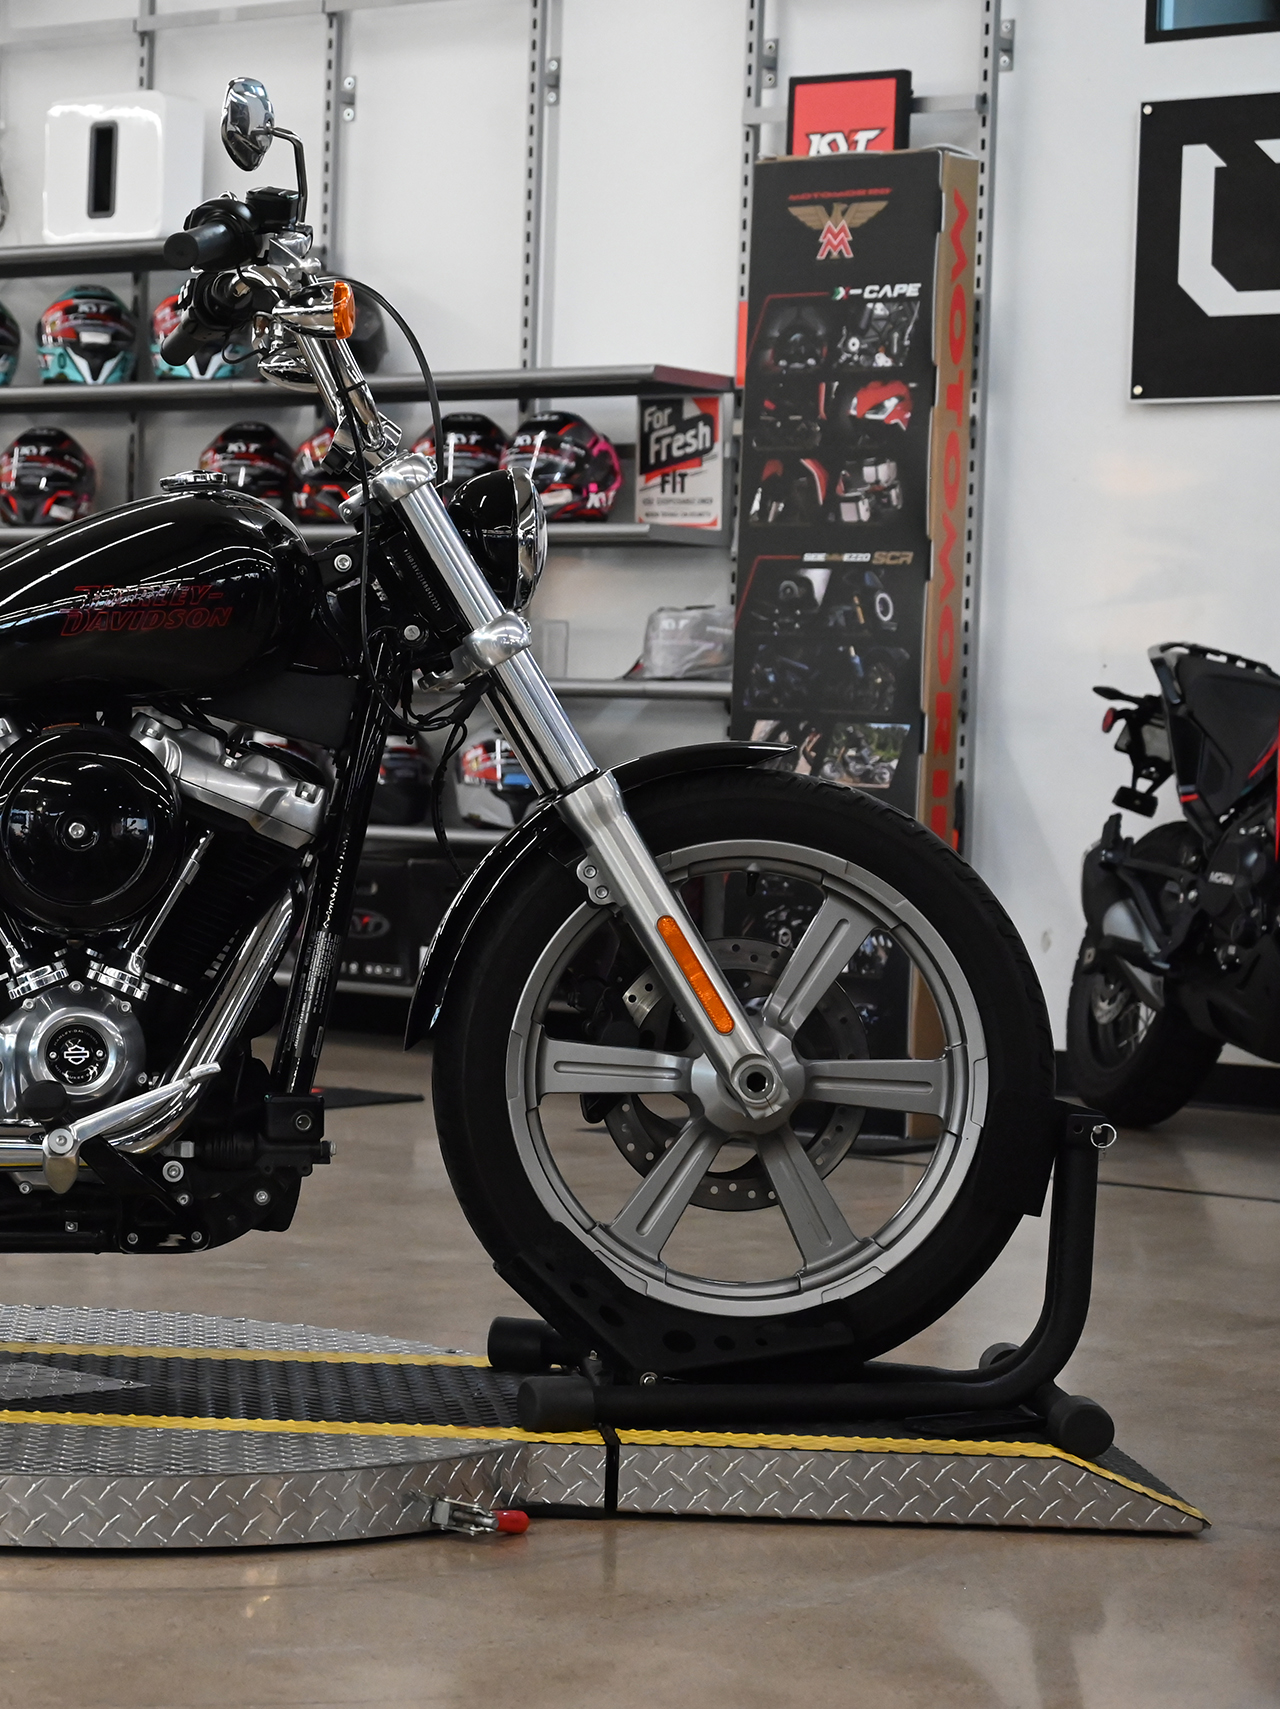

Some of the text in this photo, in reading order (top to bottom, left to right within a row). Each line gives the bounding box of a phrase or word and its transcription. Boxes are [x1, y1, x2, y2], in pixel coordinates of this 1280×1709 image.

[806, 127, 886, 156] KYT
[832, 282, 922, 301] X-CAPE
[643, 405, 673, 433] For
[649, 420, 711, 466] Fresh
[660, 470, 689, 494] FIT
[872, 550, 914, 566] SCR
[60, 606, 233, 637] DAVIDSON
